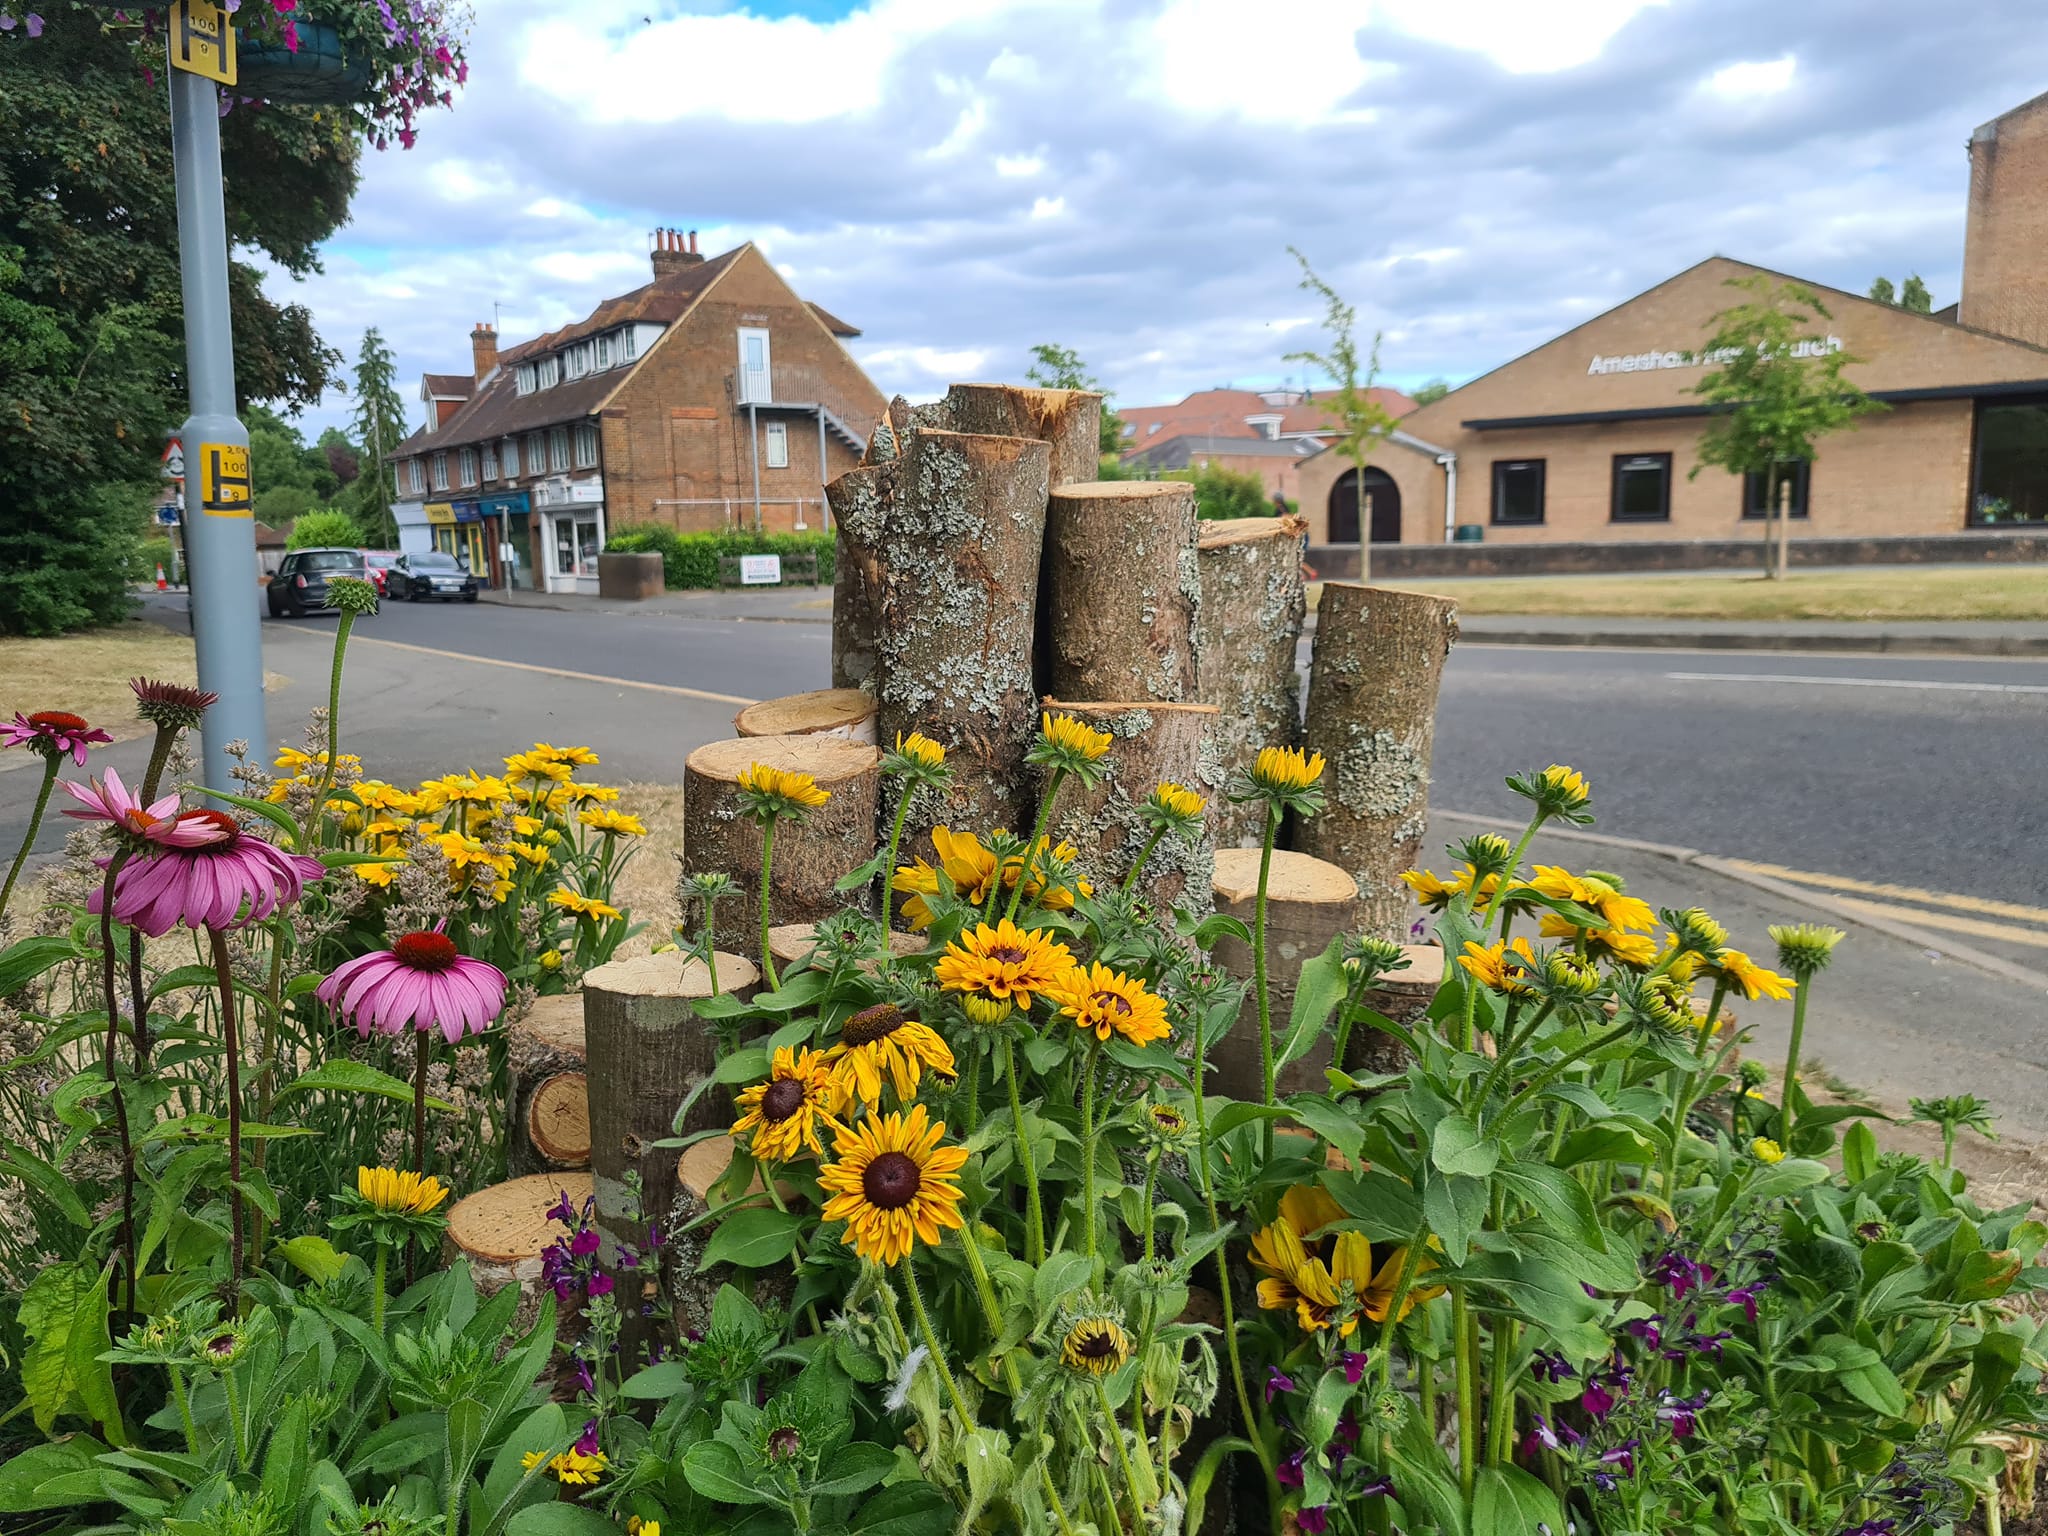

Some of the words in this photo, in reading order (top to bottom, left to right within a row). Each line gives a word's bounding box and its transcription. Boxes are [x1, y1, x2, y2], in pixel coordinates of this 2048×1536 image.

[191, 16, 216, 32] 100
[223, 462, 247, 473] 100
[232, 491, 240, 502] 9
